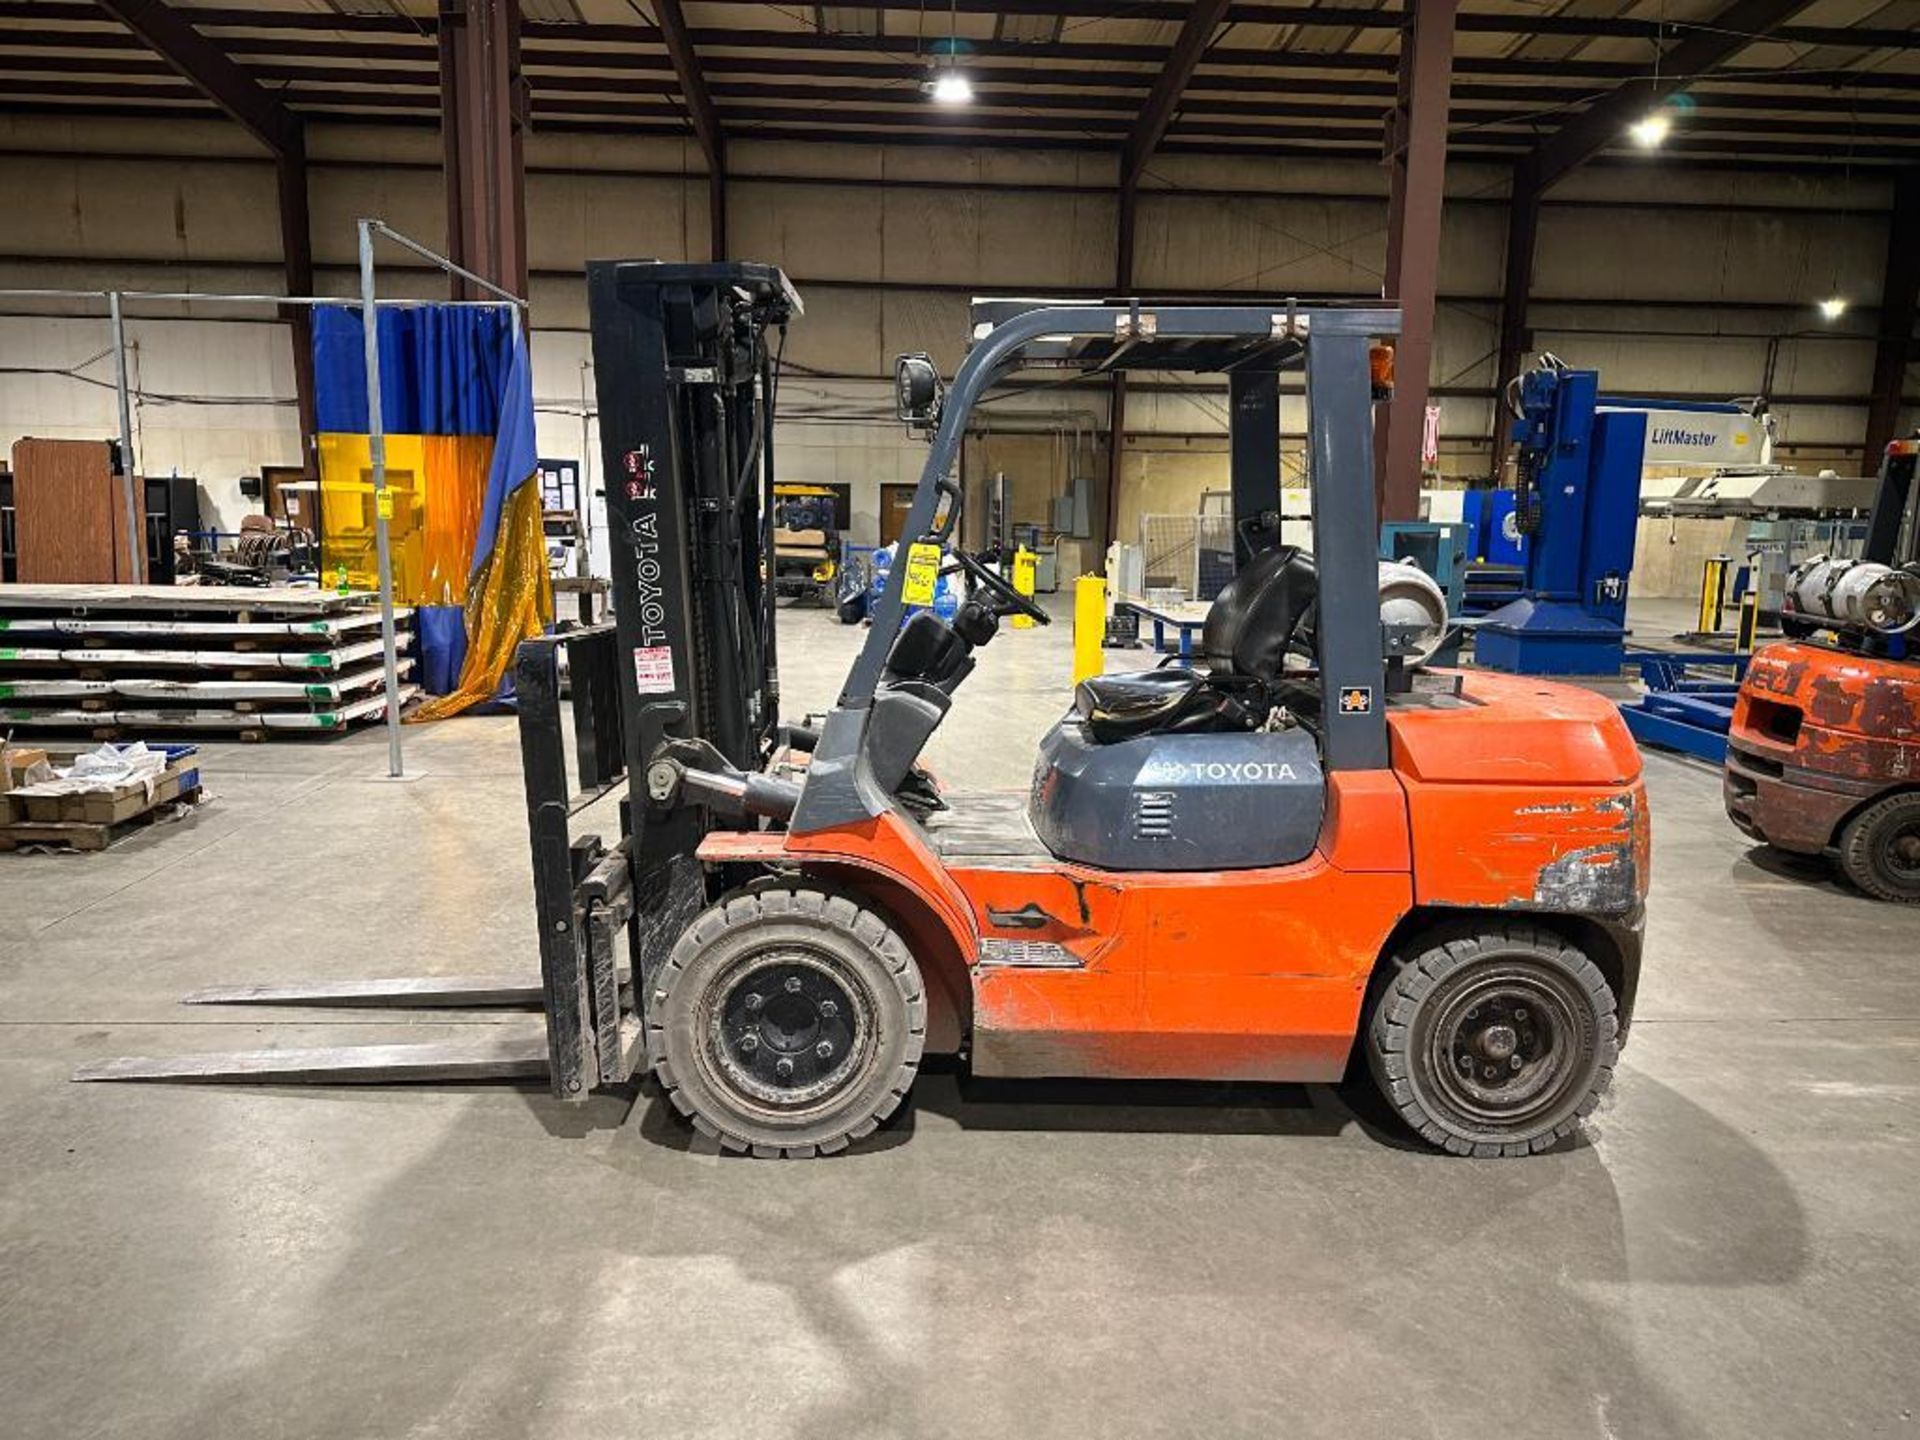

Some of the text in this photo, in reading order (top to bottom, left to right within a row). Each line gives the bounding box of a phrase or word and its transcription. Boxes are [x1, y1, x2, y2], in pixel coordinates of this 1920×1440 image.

[1651, 427, 1718, 447] LiftMaster
[633, 512, 666, 646] TOYOTA
[1191, 762, 1297, 781] TOYOTA
